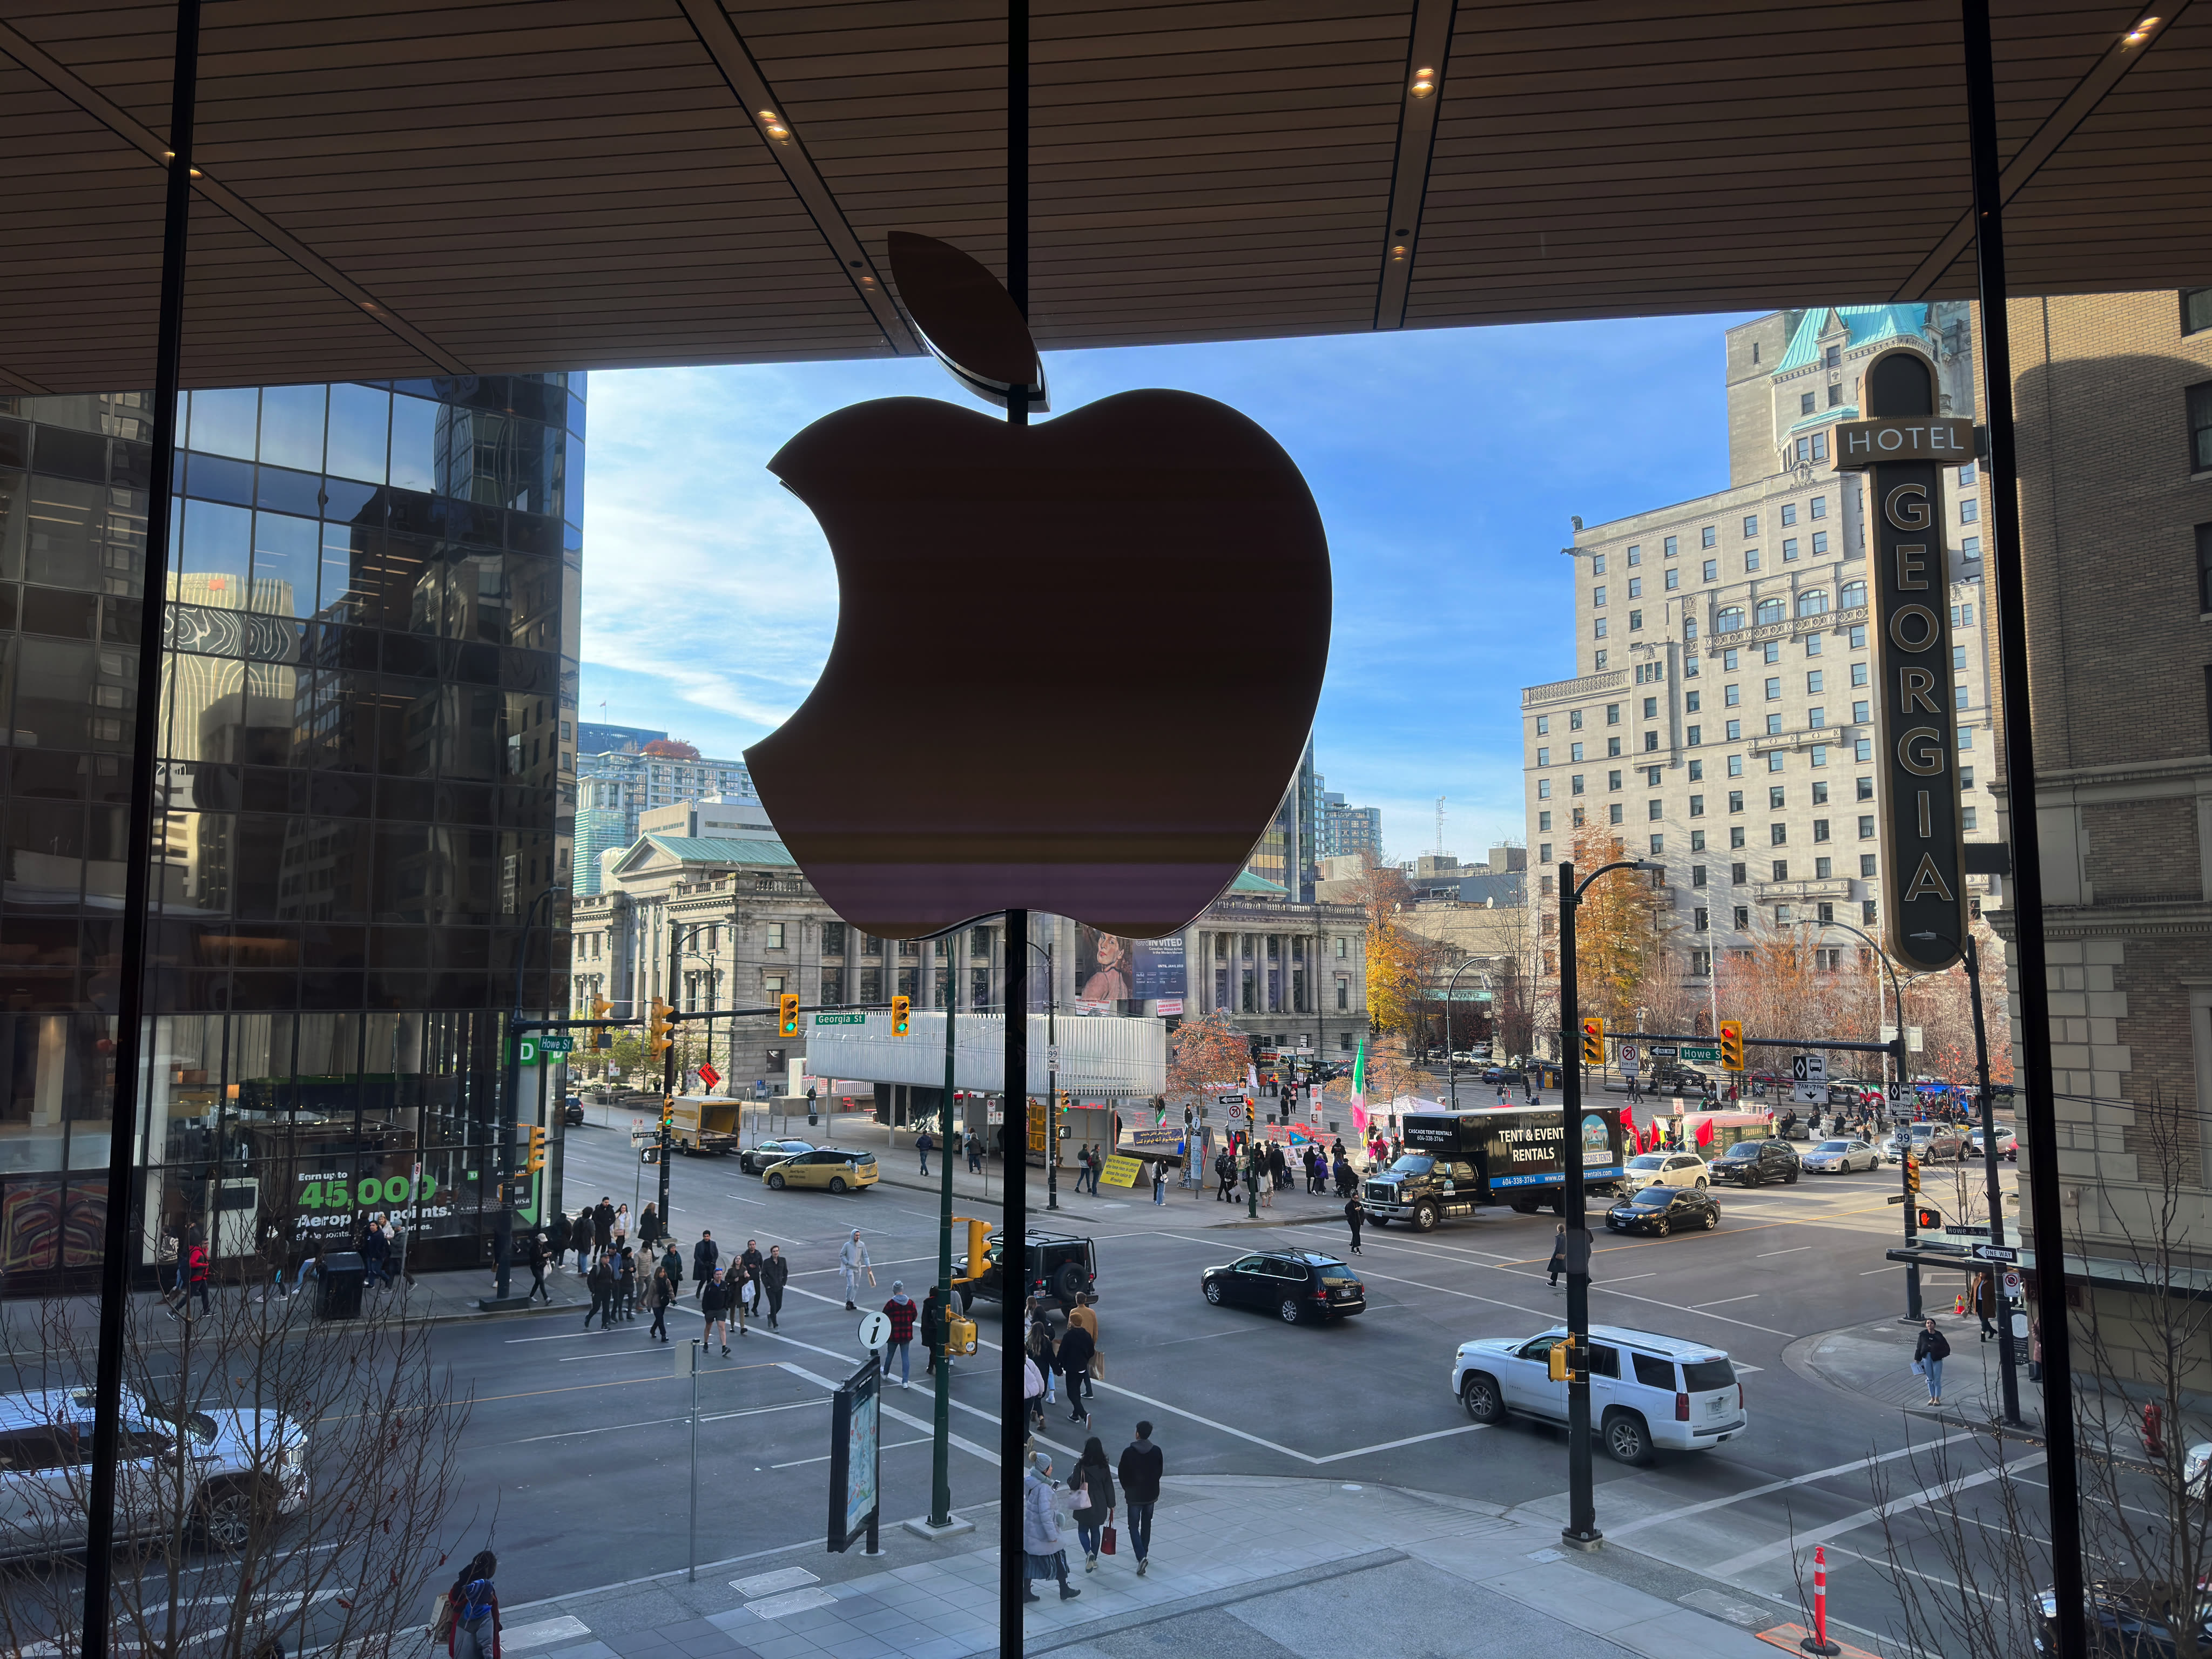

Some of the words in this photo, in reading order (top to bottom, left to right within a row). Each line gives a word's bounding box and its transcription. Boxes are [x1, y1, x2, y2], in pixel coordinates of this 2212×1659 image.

[1849, 427, 1964, 454] HOTEL
[1885, 483, 1954, 901] GEORGIA
[1136, 938, 1183, 947] UNINVITED
[818, 1015, 851, 1024] Georgia
[542, 1038, 560, 1049] Howe
[562, 1038, 570, 1049] St
[1684, 1049, 1711, 1058] Howe
[1715, 1050, 1721, 1059] S
[1498, 1129, 1524, 1143] TENT
[1526, 1129, 1533, 1141] &
[1535, 1127, 1564, 1141] EVENT
[1745, 1127, 1763, 1137] TAQUERIA
[1897, 1133, 1910, 1143] 99
[1513, 1147, 1555, 1162] RENTALS
[1582, 1154, 1598, 1164] ASCADE
[1599, 1153, 1611, 1163] TENTS
[299, 1172, 322, 1182] Earn
[1502, 1176, 1536, 1186] 604-338-3764
[298, 1174, 437, 1212] 45,000
